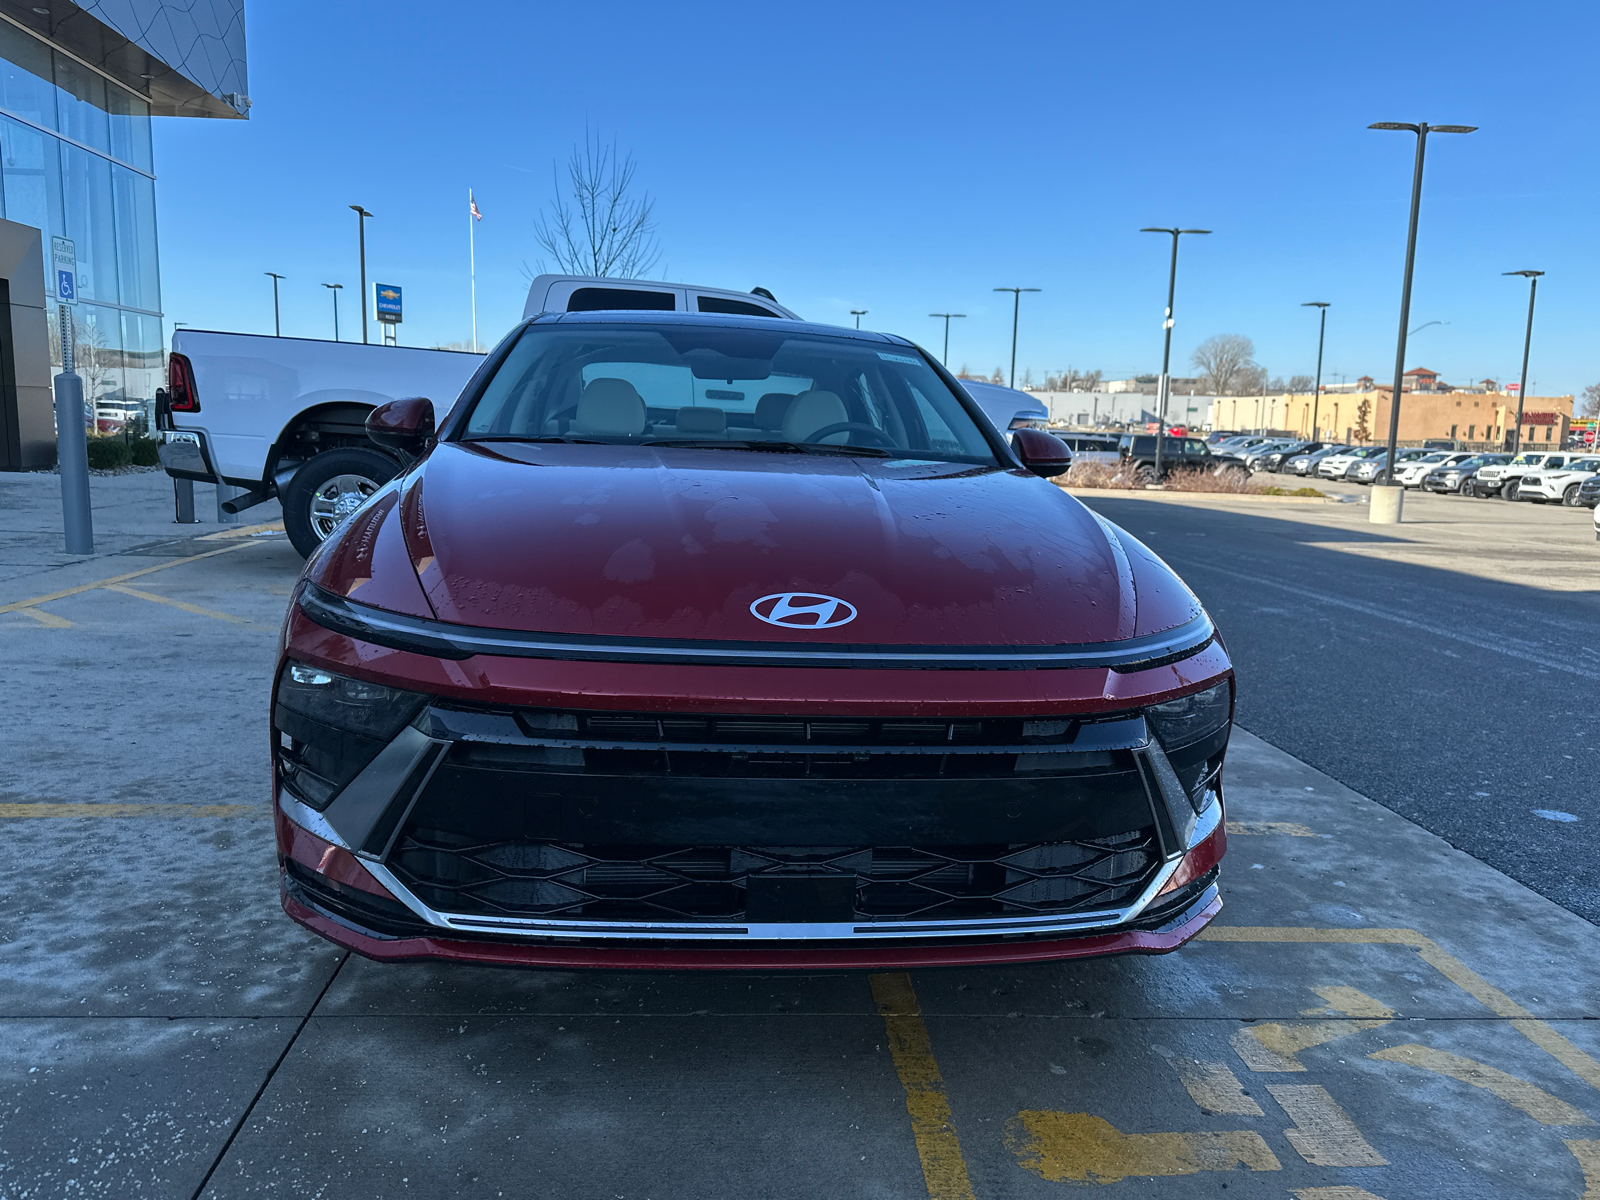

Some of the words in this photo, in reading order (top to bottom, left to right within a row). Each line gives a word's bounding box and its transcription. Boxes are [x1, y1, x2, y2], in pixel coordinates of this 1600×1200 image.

[54, 242, 74, 254] RESERVED
[54, 253, 75, 266] PARKING
[378, 302, 401, 310] CHEVROLET
